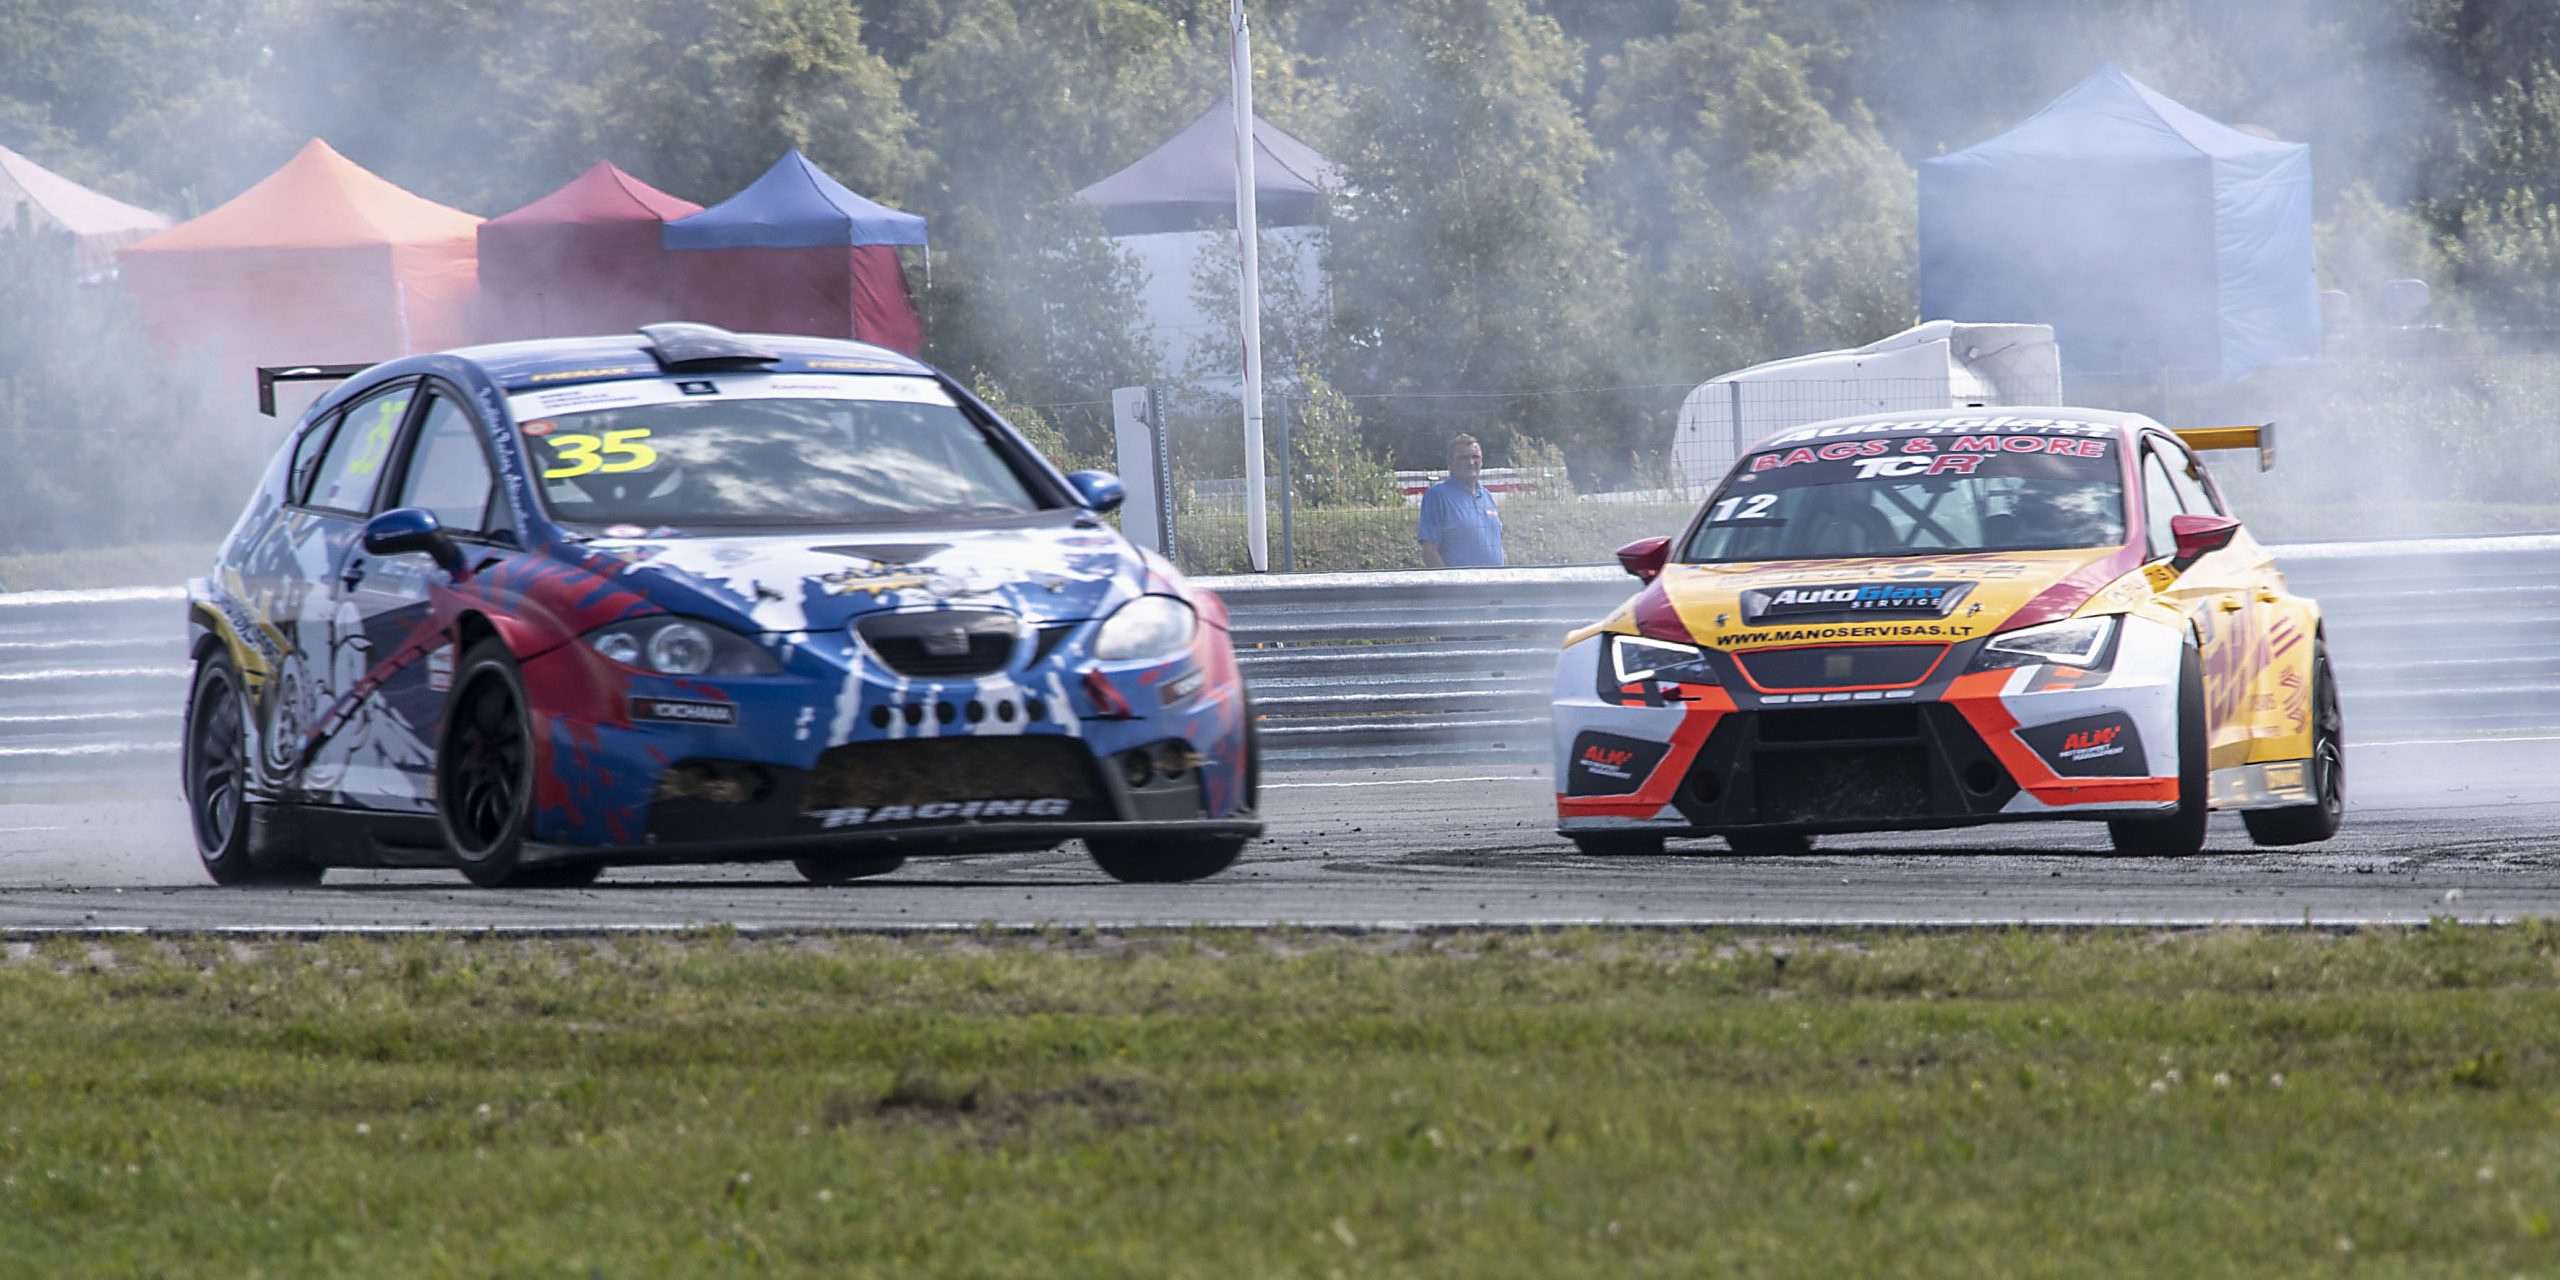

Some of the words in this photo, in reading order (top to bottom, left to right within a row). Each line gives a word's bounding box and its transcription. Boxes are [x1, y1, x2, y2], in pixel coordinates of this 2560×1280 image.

[1767, 417, 2117, 447] AutoGlass
[543, 428, 658, 479] 35
[1752, 439, 1892, 473] BAGS
[1902, 438, 1938, 454] &
[1949, 436, 2107, 458] MORE
[1851, 454, 1986, 479] TCR
[1712, 494, 1779, 523] 12
[1771, 584, 1947, 607] AutoGlass
[1849, 597, 1941, 610] SERVICE
[1716, 625, 1974, 647] WWW.MANOSERVISAS.LT
[803, 798, 1070, 829] RACING
